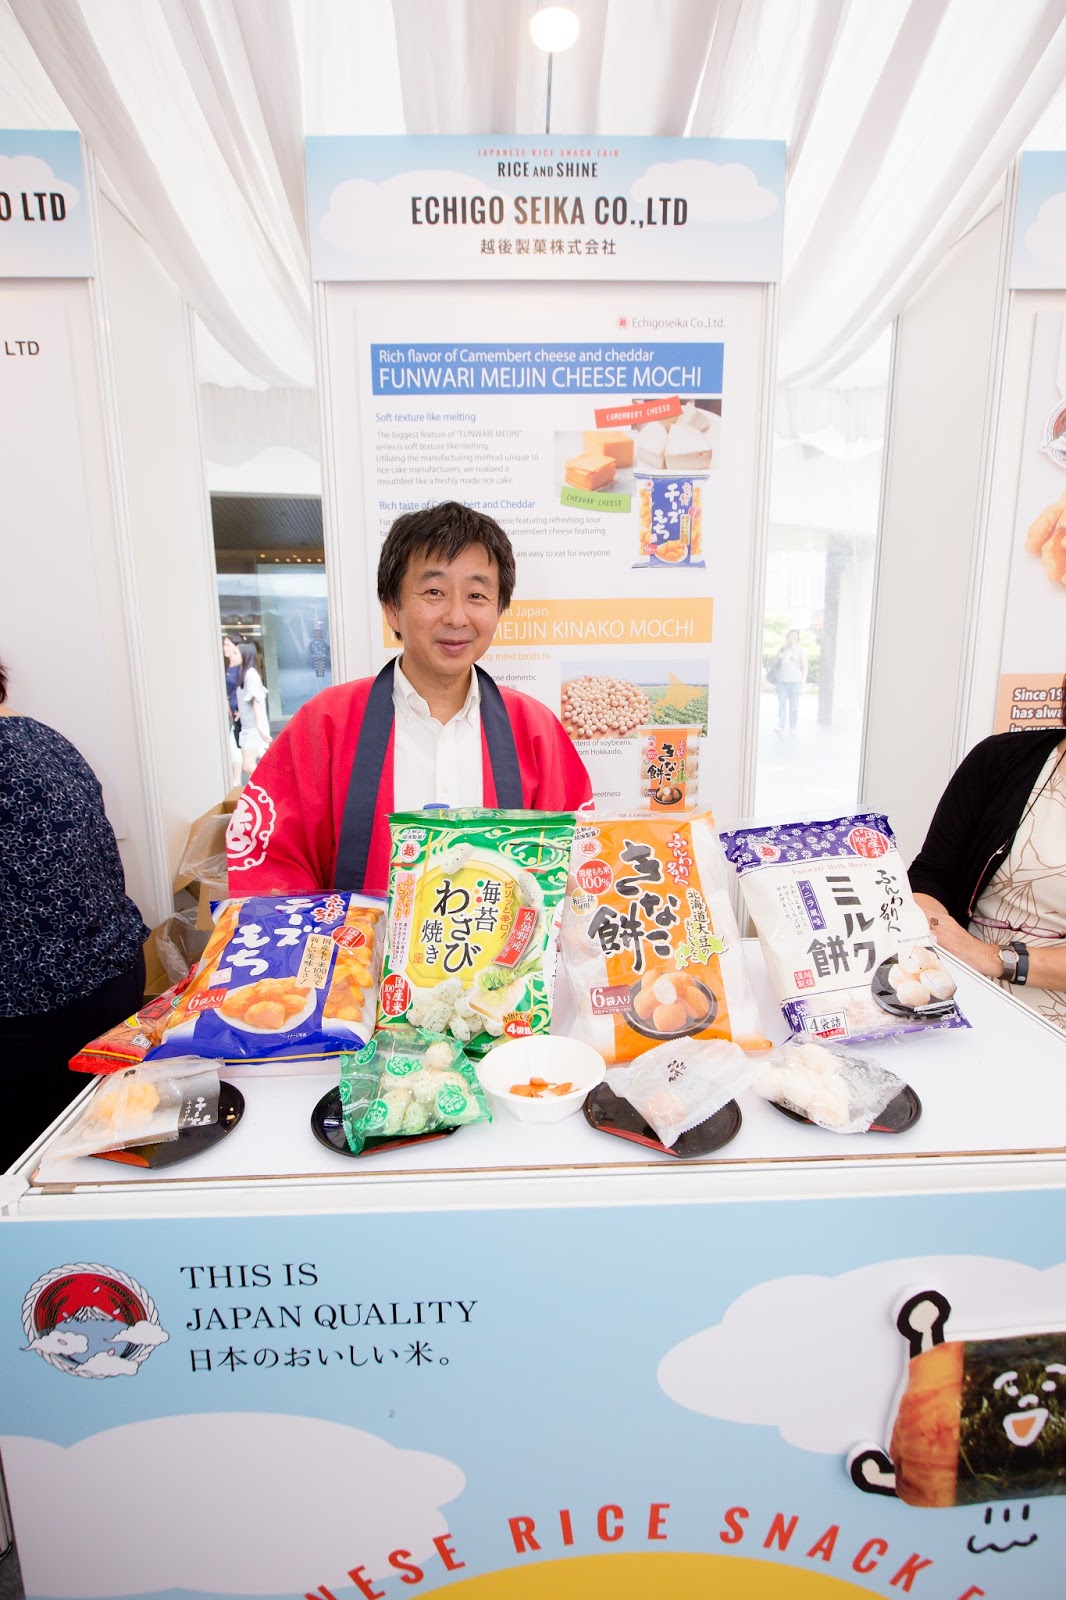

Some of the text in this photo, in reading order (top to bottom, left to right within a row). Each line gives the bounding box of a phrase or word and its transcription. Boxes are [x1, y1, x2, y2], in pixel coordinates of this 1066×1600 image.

[478, 149, 619, 158] JAPANESE RICE SNACK FAIR
[497, 161, 598, 178] RICE AND SHINE
[21, 192, 67, 222] LTD
[411, 196, 688, 228] ECHIGO SEIKA CO.,LTD
[480, 238, 617, 255] 越後製菓株式会社
[632, 317, 688, 330] Echigoseika
[5, 340, 40, 356] LTD
[379, 348, 655, 363] Rich flavor of Camembert cheese and cheddar
[379, 366, 701, 389] FUNWARI MEIJIN CHEESE MOCHI
[376, 412, 476, 424] Soft texture like melting
[606, 404, 671, 422] CAMEMBERT CHEESE
[377, 431, 390, 439] The
[392, 430, 419, 441] biggest
[420, 430, 445, 439] feature
[447, 430, 455, 438] of
[404, 442, 418, 450] soft
[447, 442, 459, 450] like
[376, 452, 539, 464] Utilizing the manufacturing method unique to
[377, 466, 389, 474] rice
[391, 465, 407, 474] cake
[476, 464, 503, 473] realized
[378, 477, 414, 486] mouthfeel
[415, 477, 427, 485] like
[435, 476, 458, 487] freshly
[460, 476, 481, 484] made
[482, 476, 494, 484] rice
[379, 499, 536, 510] Rich taste of and Cheddar
[598, 496, 622, 507] CHEESE
[379, 518, 391, 526] For
[515, 516, 548, 526] featuring
[549, 516, 584, 526] refreshing
[653, 509, 670, 540] もち
[507, 528, 547, 536] camembert
[574, 528, 606, 537] featuring
[529, 551, 544, 559] easy
[567, 549, 577, 557] for
[515, 606, 548, 619] Japan
[553, 620, 624, 638] KINAKO
[630, 619, 694, 637] MOCHI
[496, 652, 516, 661] mind
[517, 652, 541, 660] tends
[542, 652, 551, 660] to
[506, 673, 536, 681] domestic
[1012, 688, 1048, 702] Since
[1011, 705, 1063, 719] has alwa
[579, 866, 611, 877] 国産もち米
[792, 866, 824, 875] Funwari
[827, 863, 845, 871] Milk
[581, 876, 612, 889] 100%
[614, 840, 680, 957] きなこ
[875, 870, 903, 921] ふんわり
[474, 880, 502, 933] 海苔
[801, 883, 823, 927] バニラ風味
[433, 880, 482, 973] わさび
[687, 890, 711, 955] 北海道大豆の
[825, 876, 876, 974] ミルク
[421, 919, 443, 965] 焼き
[588, 902, 644, 973] 餅
[226, 923, 270, 976] もち
[806, 935, 850, 978] 餅
[392, 976, 406, 1014] 国産米
[592, 988, 630, 1008] 6袋入り
[810, 1016, 842, 1032] 4袋詰
[180, 1262, 319, 1290] THIS IS
[186, 1300, 479, 1332] JAPAN QUALITY
[508, 1503, 934, 1593] RICE SNACK
